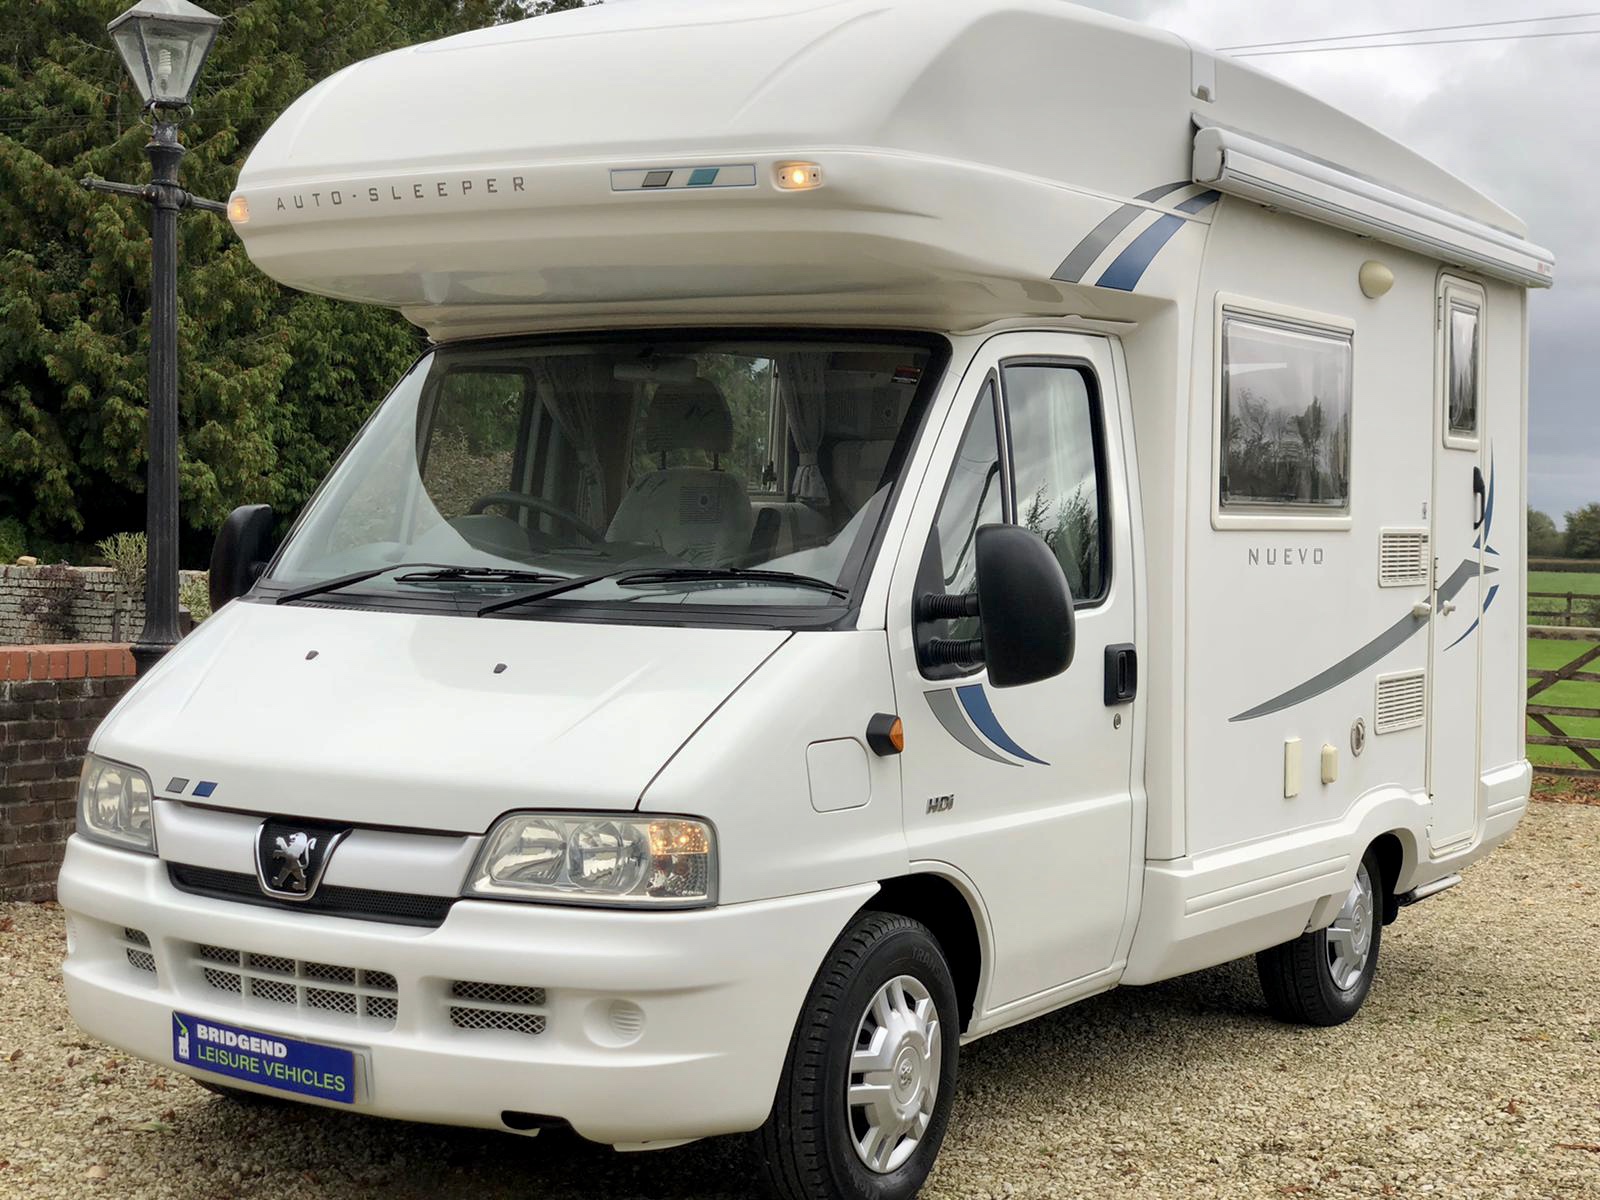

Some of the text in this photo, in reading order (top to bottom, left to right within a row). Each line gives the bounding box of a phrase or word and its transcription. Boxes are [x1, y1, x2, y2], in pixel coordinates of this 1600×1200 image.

[1248, 547, 1324, 565] NUEVO
[926, 794, 954, 815] HDi
[196, 1023, 288, 1058] BRIDGEND
[198, 1044, 346, 1092] LEISURE VEHICLES
